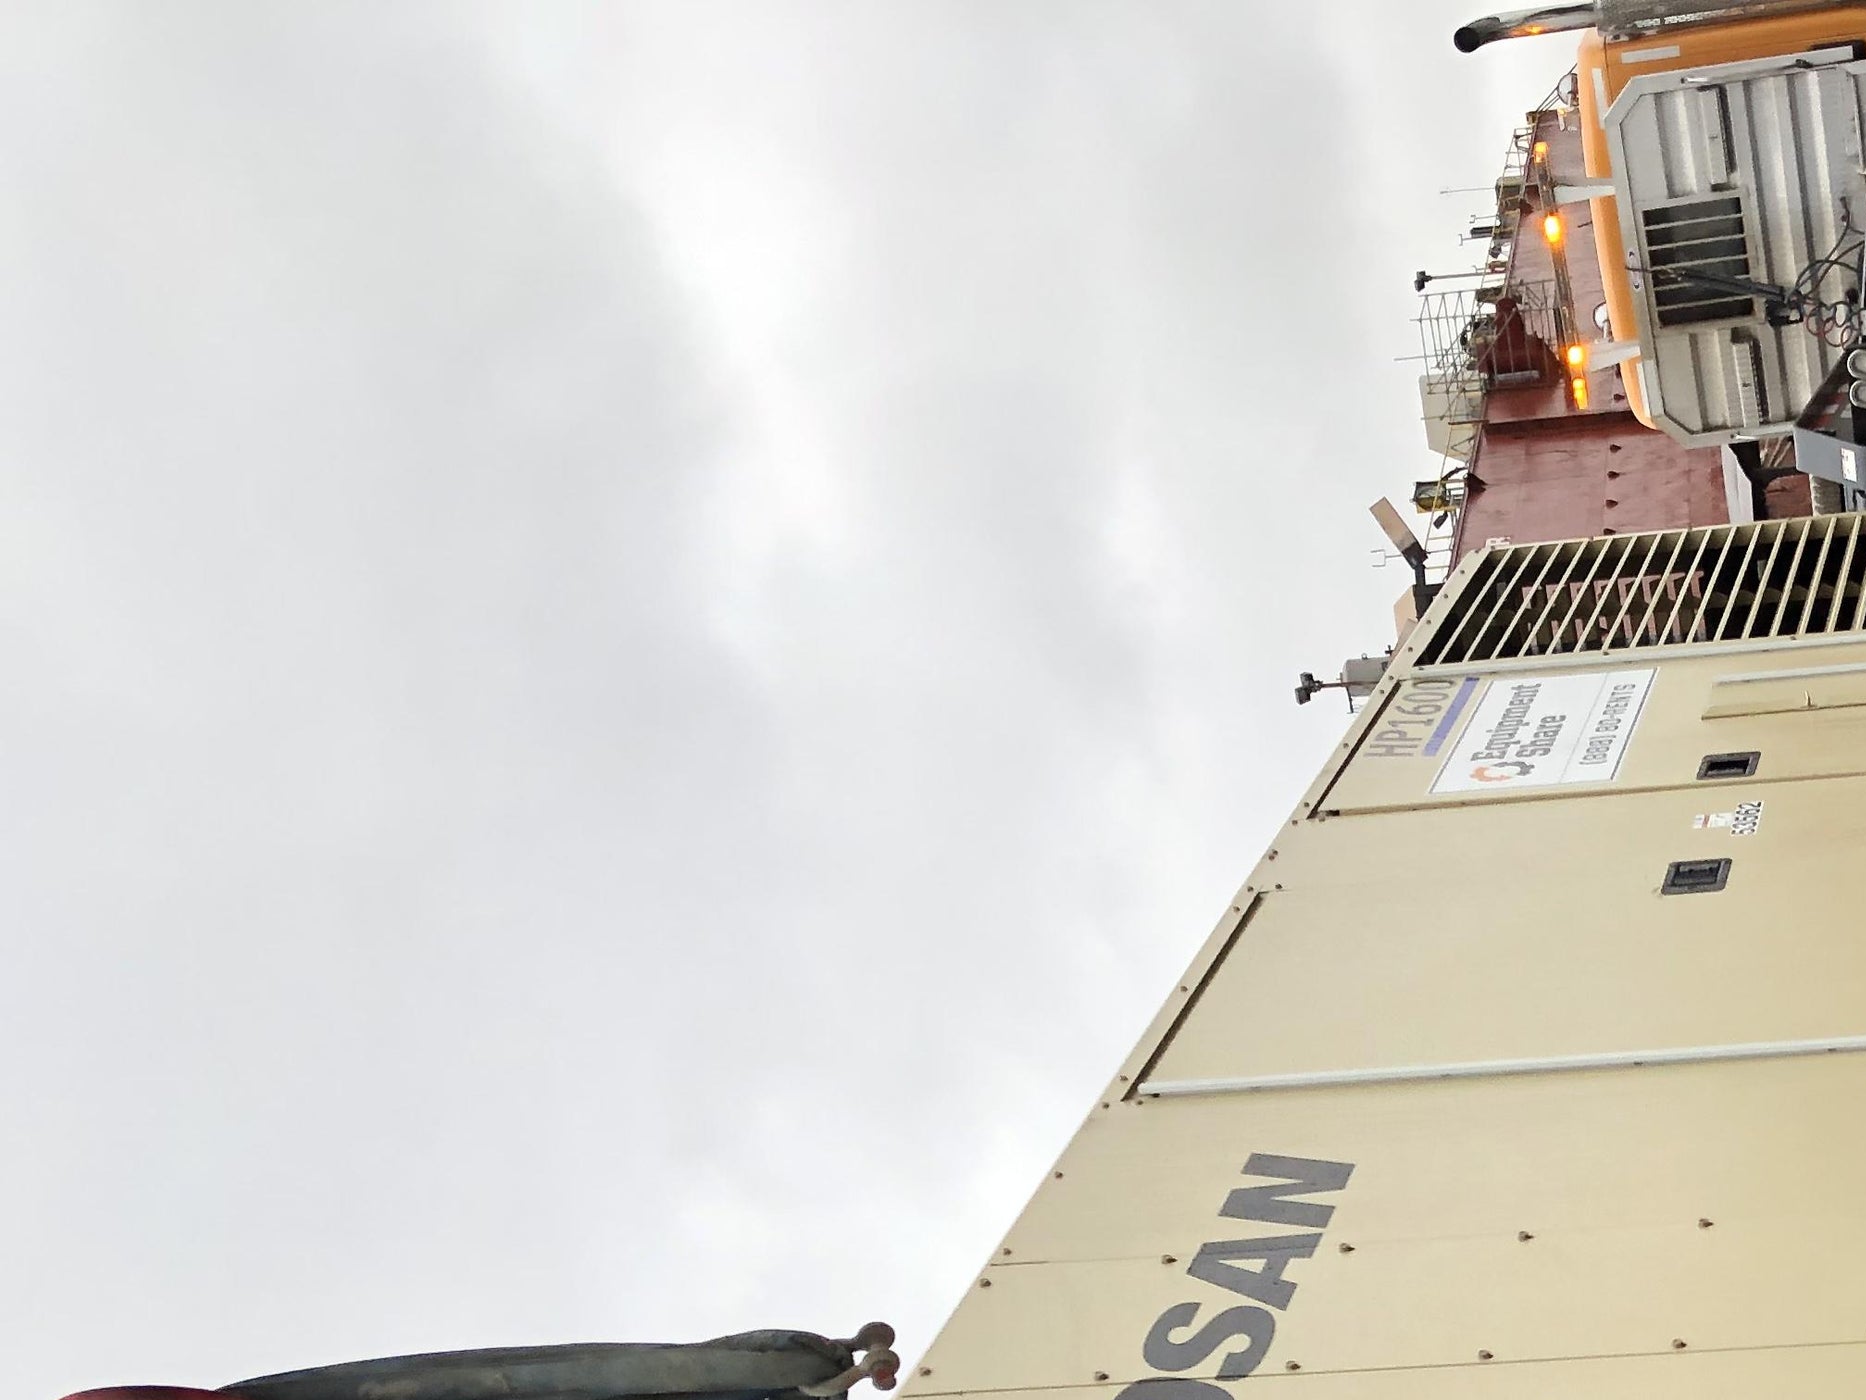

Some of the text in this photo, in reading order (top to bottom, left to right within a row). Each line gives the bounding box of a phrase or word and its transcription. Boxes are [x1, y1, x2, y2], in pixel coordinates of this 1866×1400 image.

[1364, 679, 1455, 758] HP1600
[1470, 683, 1542, 761] Equipment
[1514, 714, 1567, 757] Share
[1578, 684, 1637, 765] (888) 80-RENTS
[1731, 801, 1762, 835] 53562
